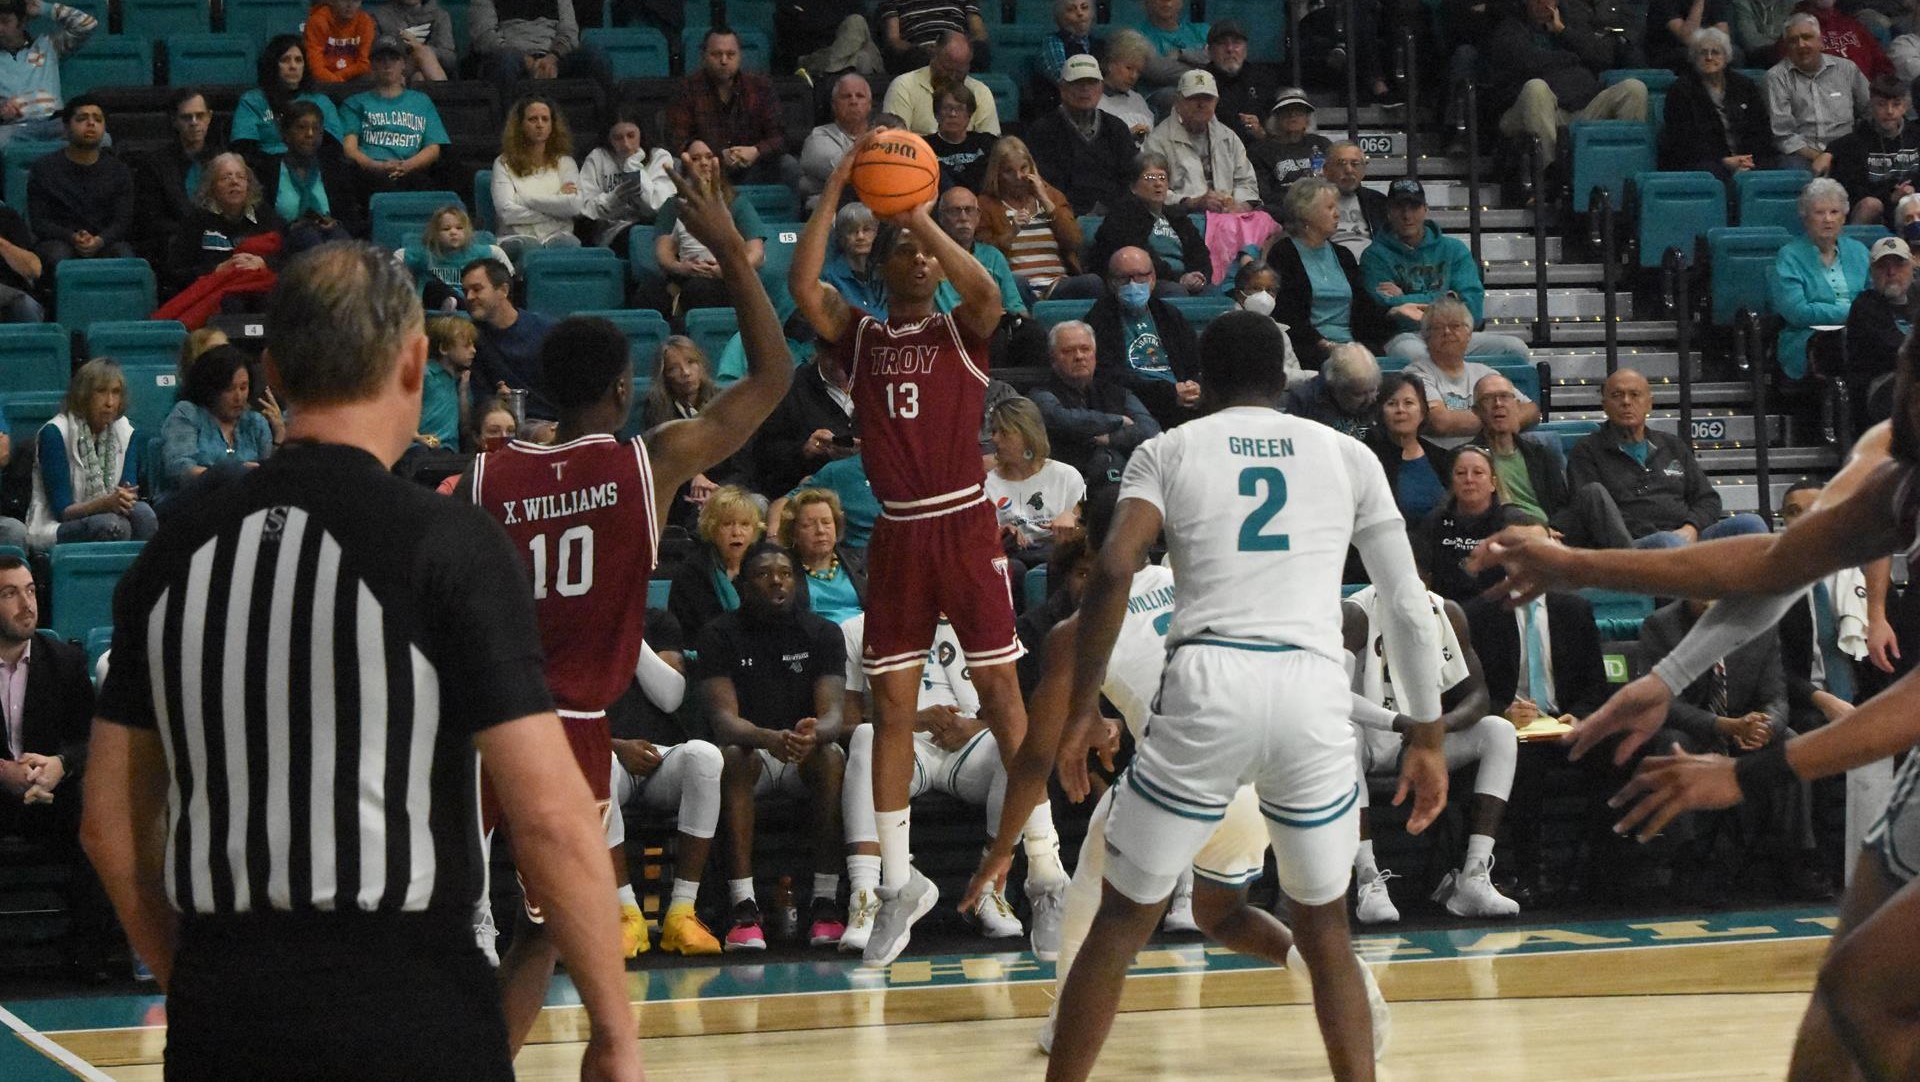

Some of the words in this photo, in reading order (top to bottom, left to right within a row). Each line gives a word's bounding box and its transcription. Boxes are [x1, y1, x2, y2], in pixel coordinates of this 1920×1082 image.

[871, 345, 940, 376] TROY
[886, 382, 919, 419] 13
[1229, 436, 1296, 458] GREEN
[1237, 466, 1291, 552] 2
[528, 524, 594, 600] 10
